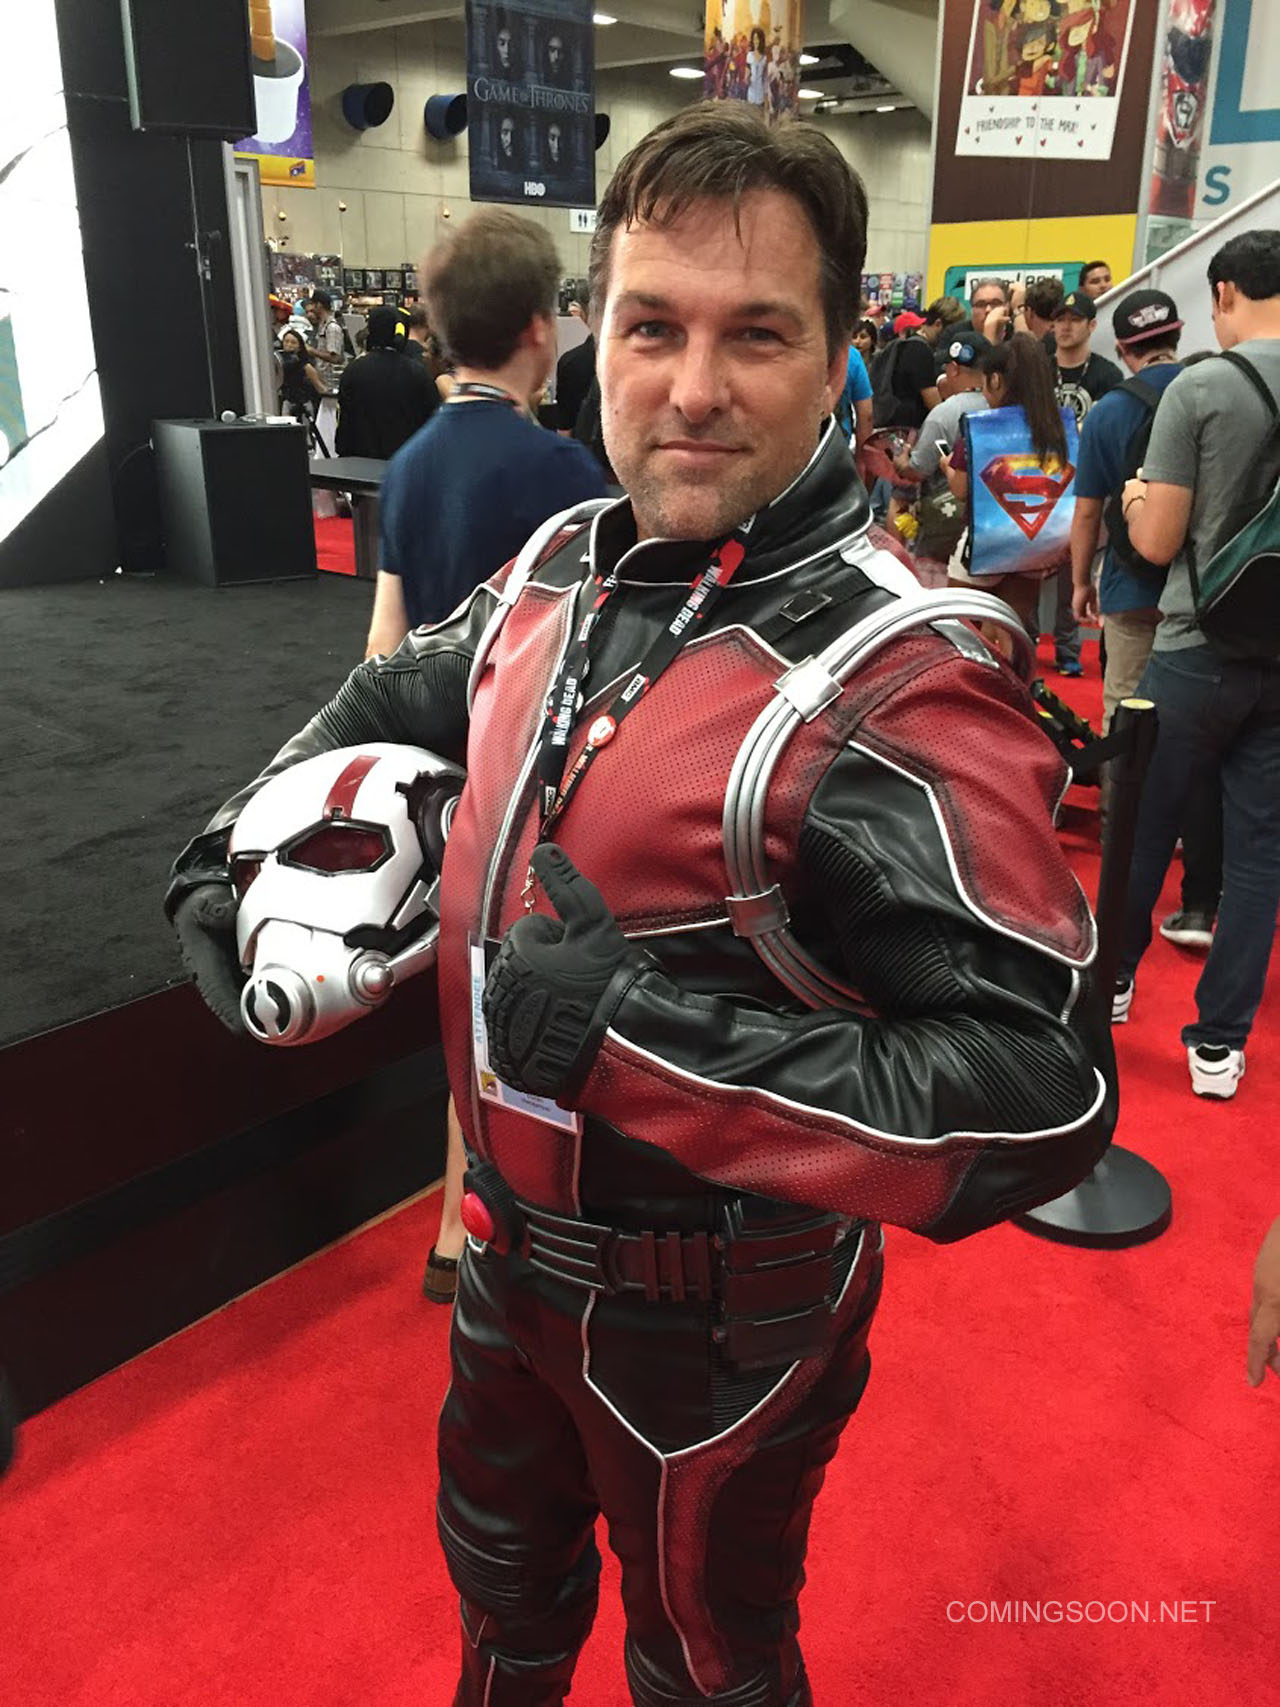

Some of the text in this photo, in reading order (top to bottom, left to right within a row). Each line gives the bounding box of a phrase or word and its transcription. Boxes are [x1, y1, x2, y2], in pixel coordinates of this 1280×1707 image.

[474, 76, 519, 103] GAME
[527, 84, 591, 112] THRONES
[976, 116, 1022, 132] FRIENDSHIP
[1026, 116, 1036, 129] TO
[1040, 118, 1055, 131] THE
[524, 181, 546, 197] HBO
[668, 564, 724, 636] WALKING DEAD
[551, 677, 578, 746] WALKING DEAD
[473, 977, 484, 1044] ATTENDEE
